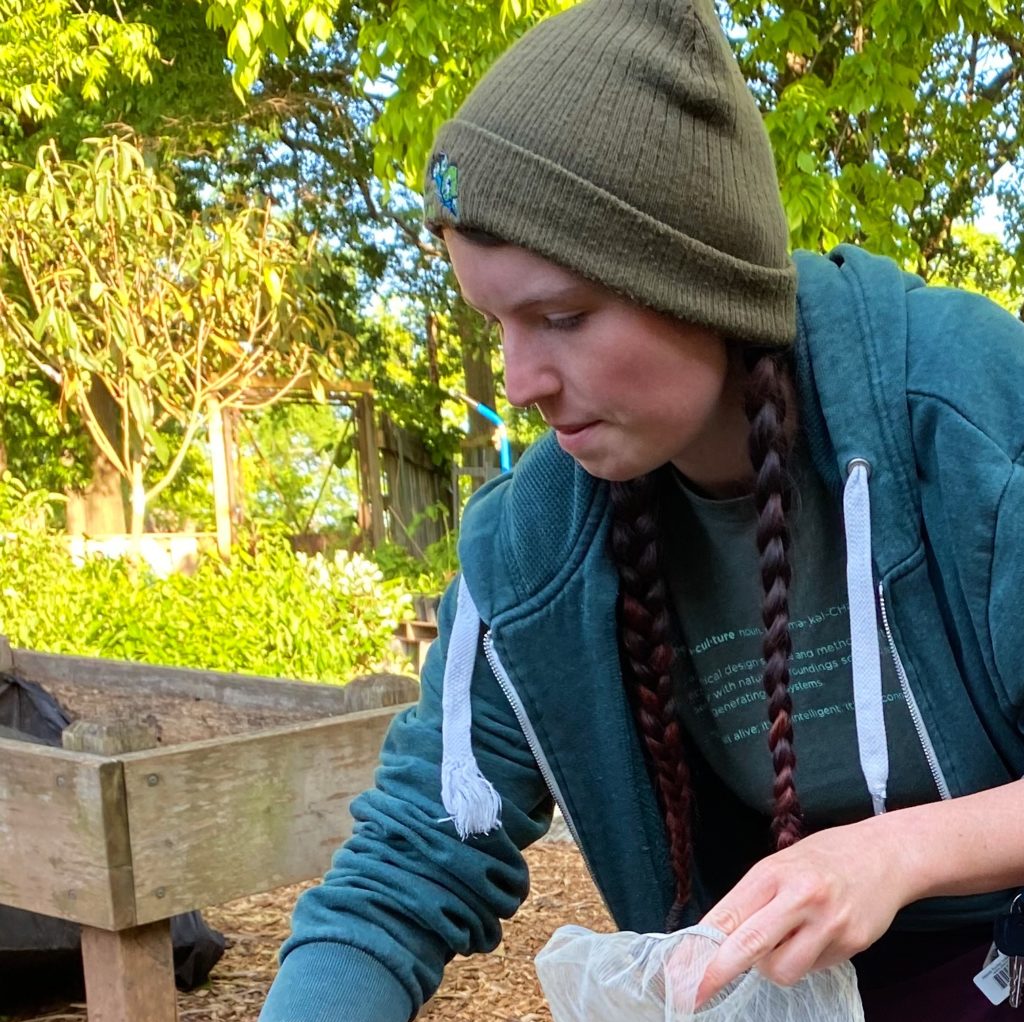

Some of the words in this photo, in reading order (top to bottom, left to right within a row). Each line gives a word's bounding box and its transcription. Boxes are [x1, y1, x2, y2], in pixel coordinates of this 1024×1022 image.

[703, 668, 722, 685] ical
[724, 657, 759, 675] design
[795, 649, 816, 660] and
[816, 637, 852, 656] metho
[712, 681, 737, 699] with
[738, 673, 763, 689] natu
